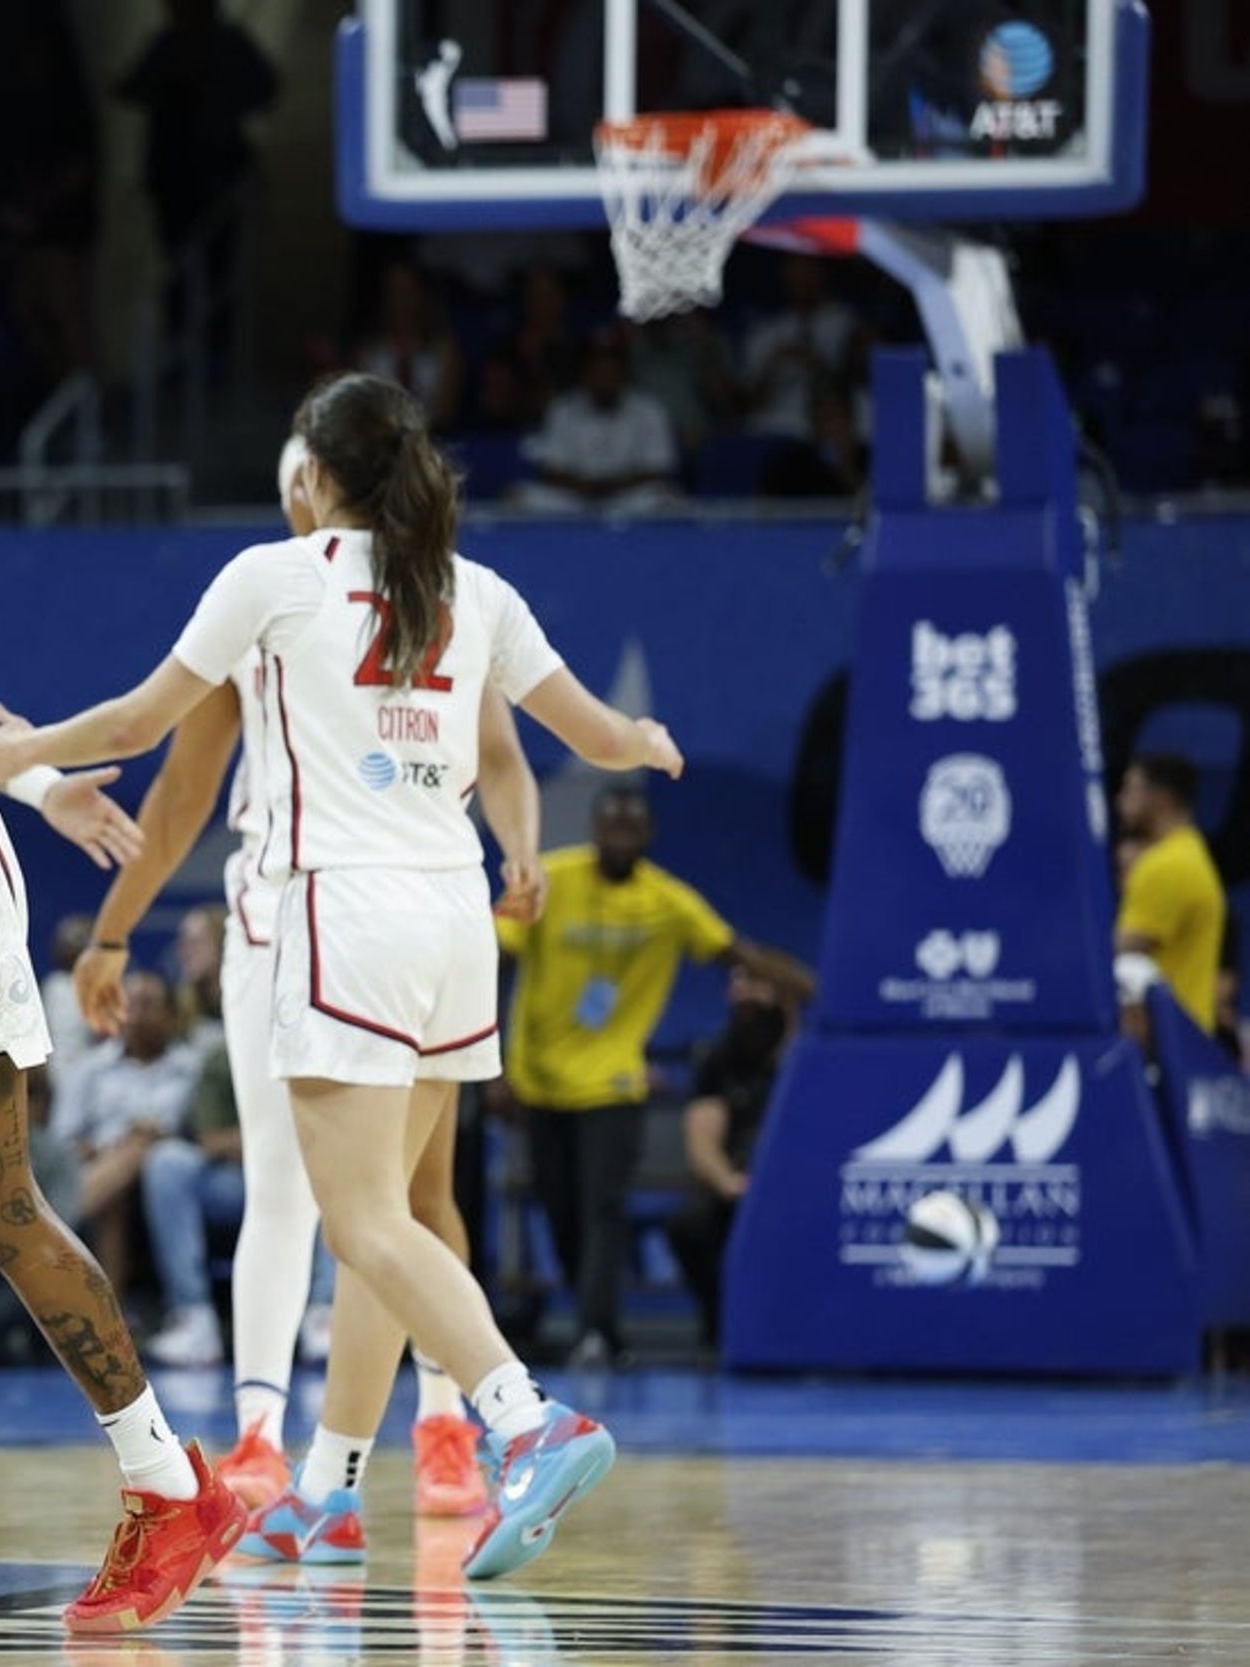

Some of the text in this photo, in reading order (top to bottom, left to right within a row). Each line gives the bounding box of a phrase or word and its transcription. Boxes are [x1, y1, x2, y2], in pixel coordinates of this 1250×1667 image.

[969, 100, 1064, 140] AT&T
[347, 590, 454, 692] 22
[912, 619, 1016, 674] bet
[909, 674, 1017, 722] 365
[378, 705, 439, 743] CITRON
[841, 1181, 1081, 1218] MALLAN
